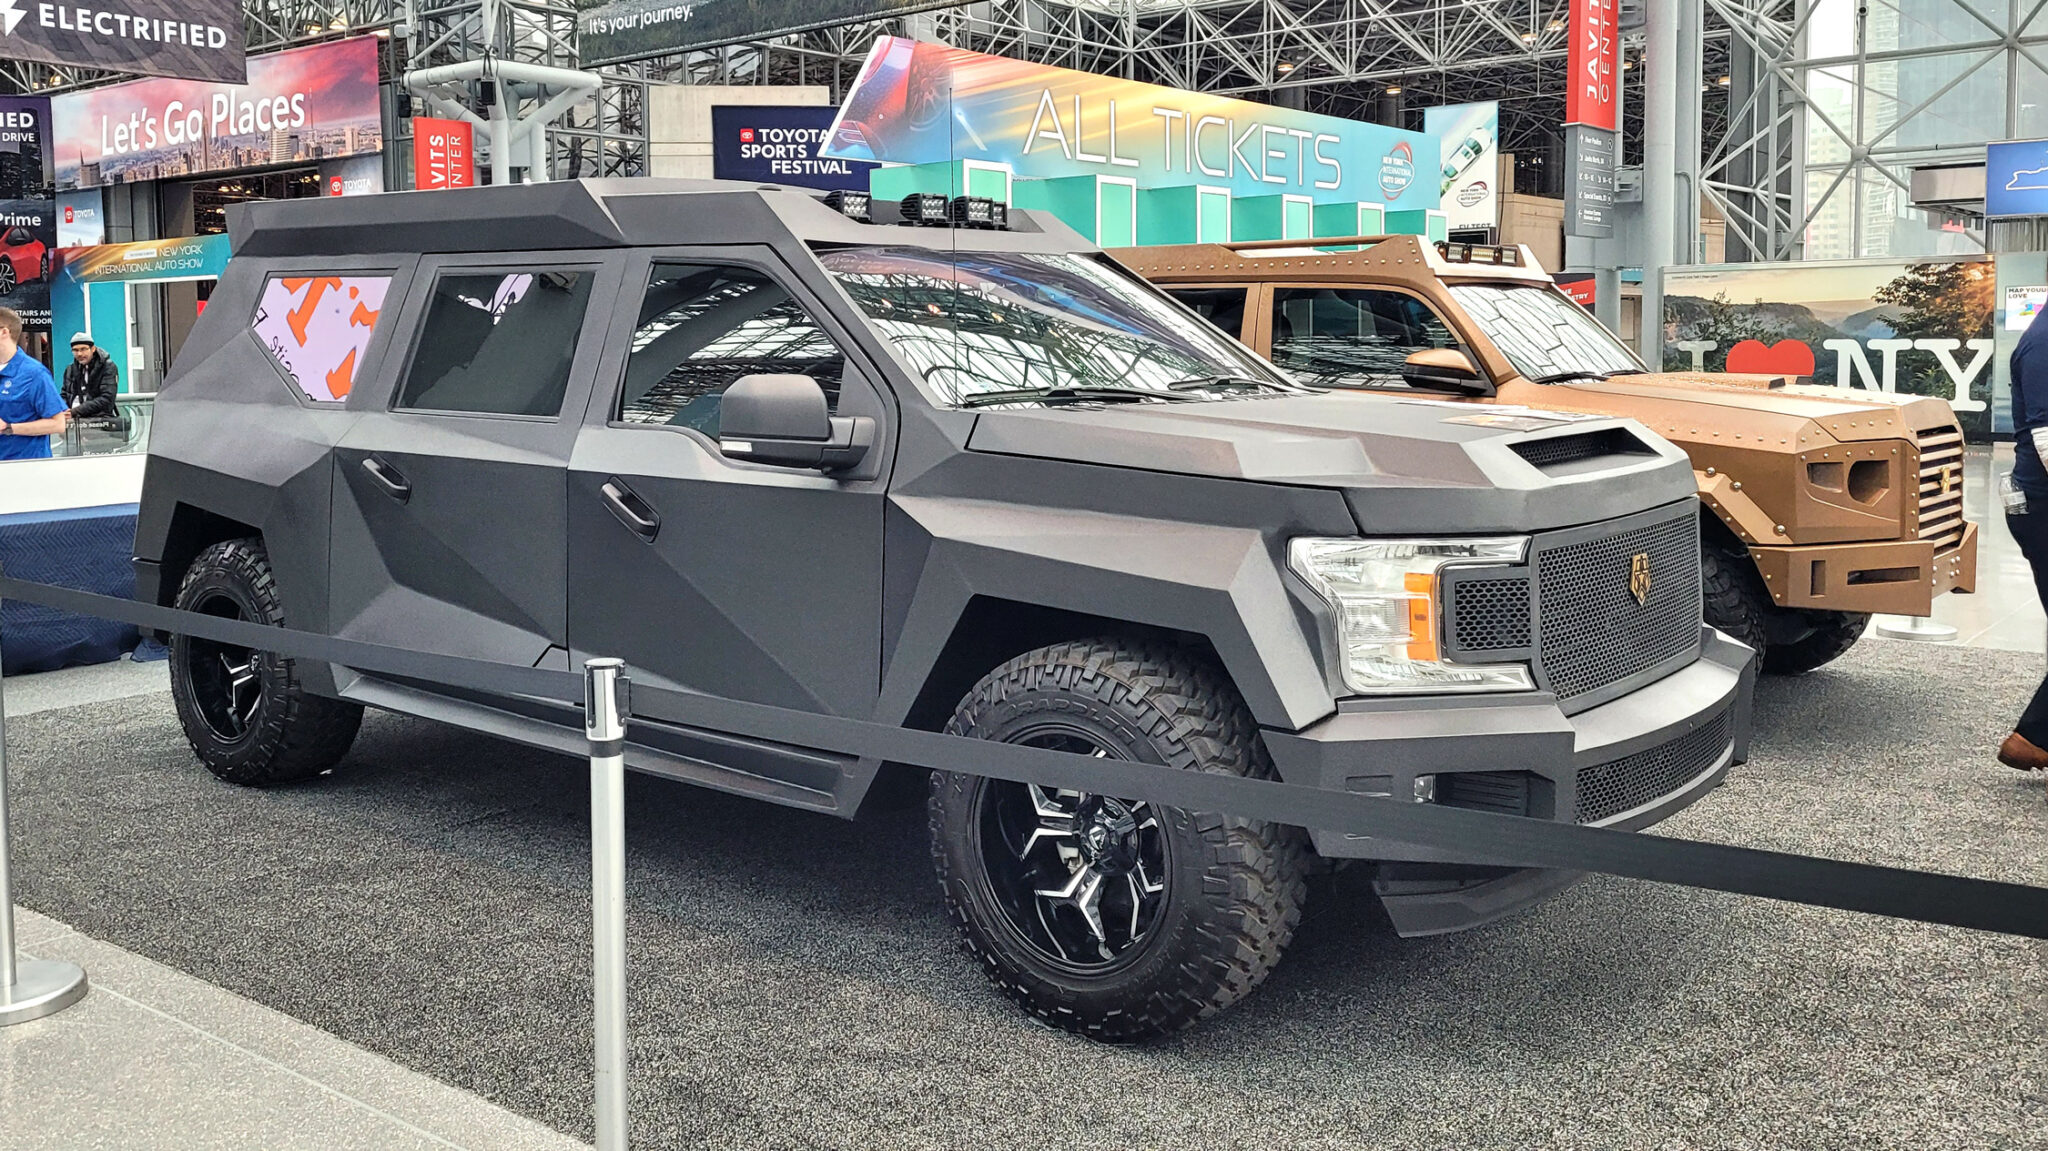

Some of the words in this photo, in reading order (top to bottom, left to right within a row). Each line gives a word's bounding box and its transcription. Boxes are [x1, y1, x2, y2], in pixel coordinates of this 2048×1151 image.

[39, 3, 227, 49] ELECTRIFIED
[589, 17, 607, 35] It's
[608, 14, 639, 35] your
[640, 4, 694, 30] journey.
[101, 107, 157, 156] Let's
[163, 100, 204, 146] Go
[211, 88, 305, 139] Places
[2, 132, 35, 142] DRIVE
[758, 128, 831, 143] TOYOTA
[1022, 88, 1140, 168] ALL
[1152, 107, 1342, 191] TICKETS
[741, 144, 807, 158] SPORTS
[430, 134, 446, 190] VITS
[450, 136, 463, 184] NTER
[771, 160, 852, 174] FESTIVAL
[343, 178, 372, 190] TOYOTA
[74, 208, 95, 218] TOYOTA
[160, 247, 178, 257] NEW
[180, 244, 204, 255] YORK
[95, 262, 153, 275] INTERNATIONAL
[155, 259, 177, 271] AUTO
[178, 258, 204, 270] SHOW
[15, 309, 39, 317] STAIRS
[1822, 338, 1994, 411] NY
